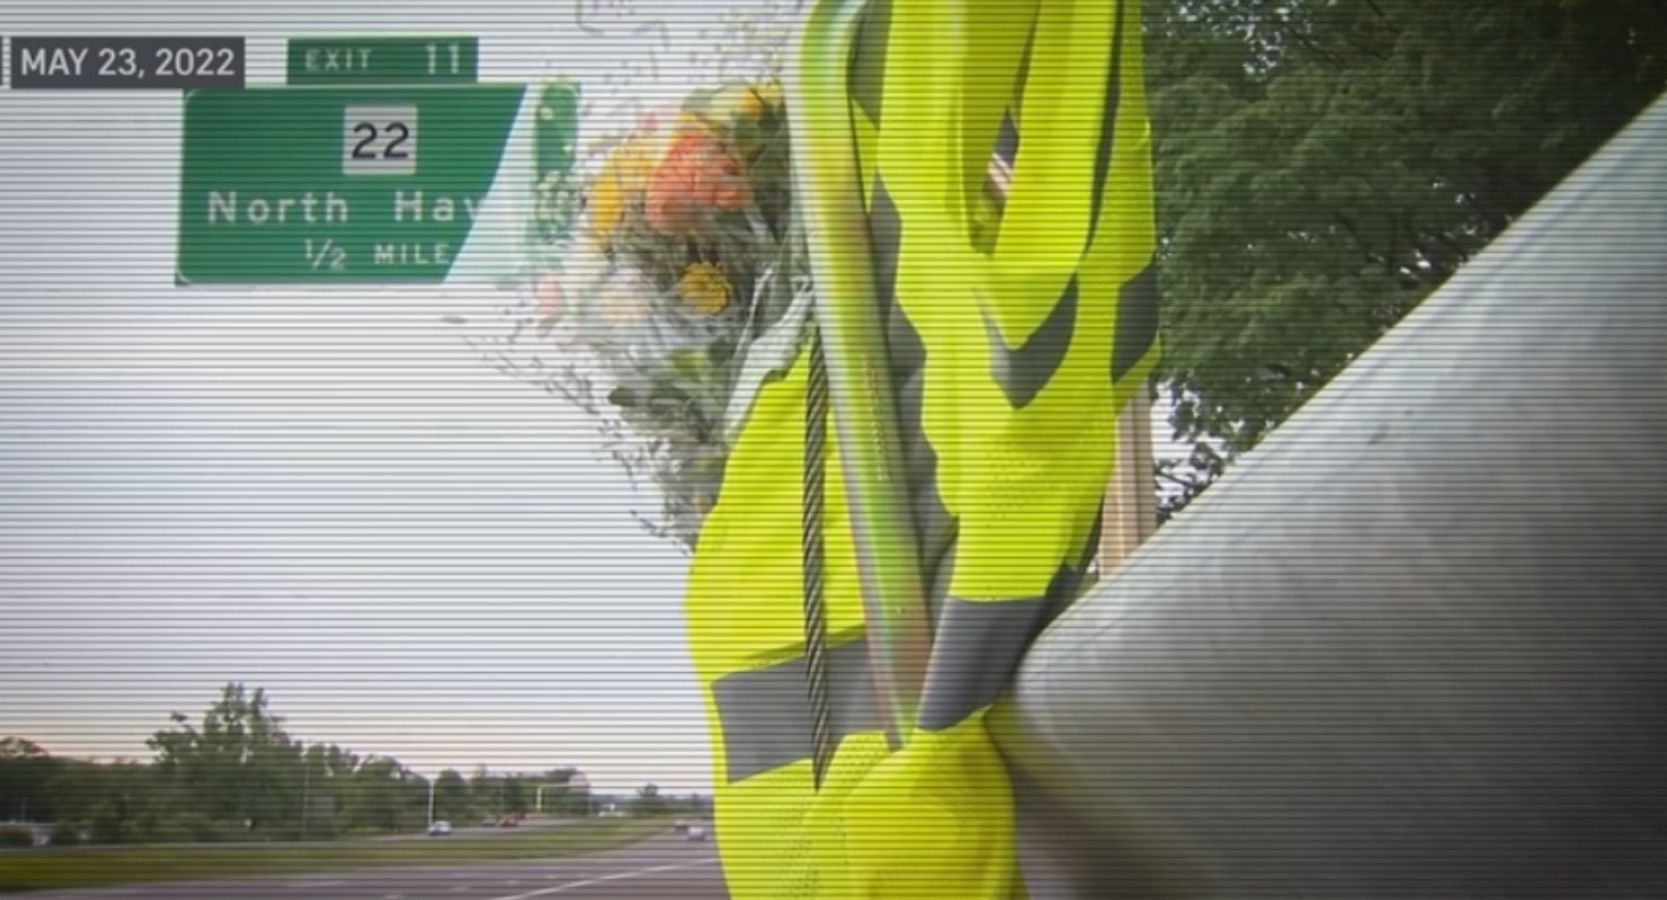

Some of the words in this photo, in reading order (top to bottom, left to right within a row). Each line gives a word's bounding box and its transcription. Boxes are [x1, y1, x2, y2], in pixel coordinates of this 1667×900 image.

[304, 48, 372, 71] EXIT
[426, 43, 460, 75] 11
[352, 122, 409, 159] 22
[207, 190, 349, 223] North
[394, 190, 482, 223] Hav
[374, 243, 450, 266] MILE
